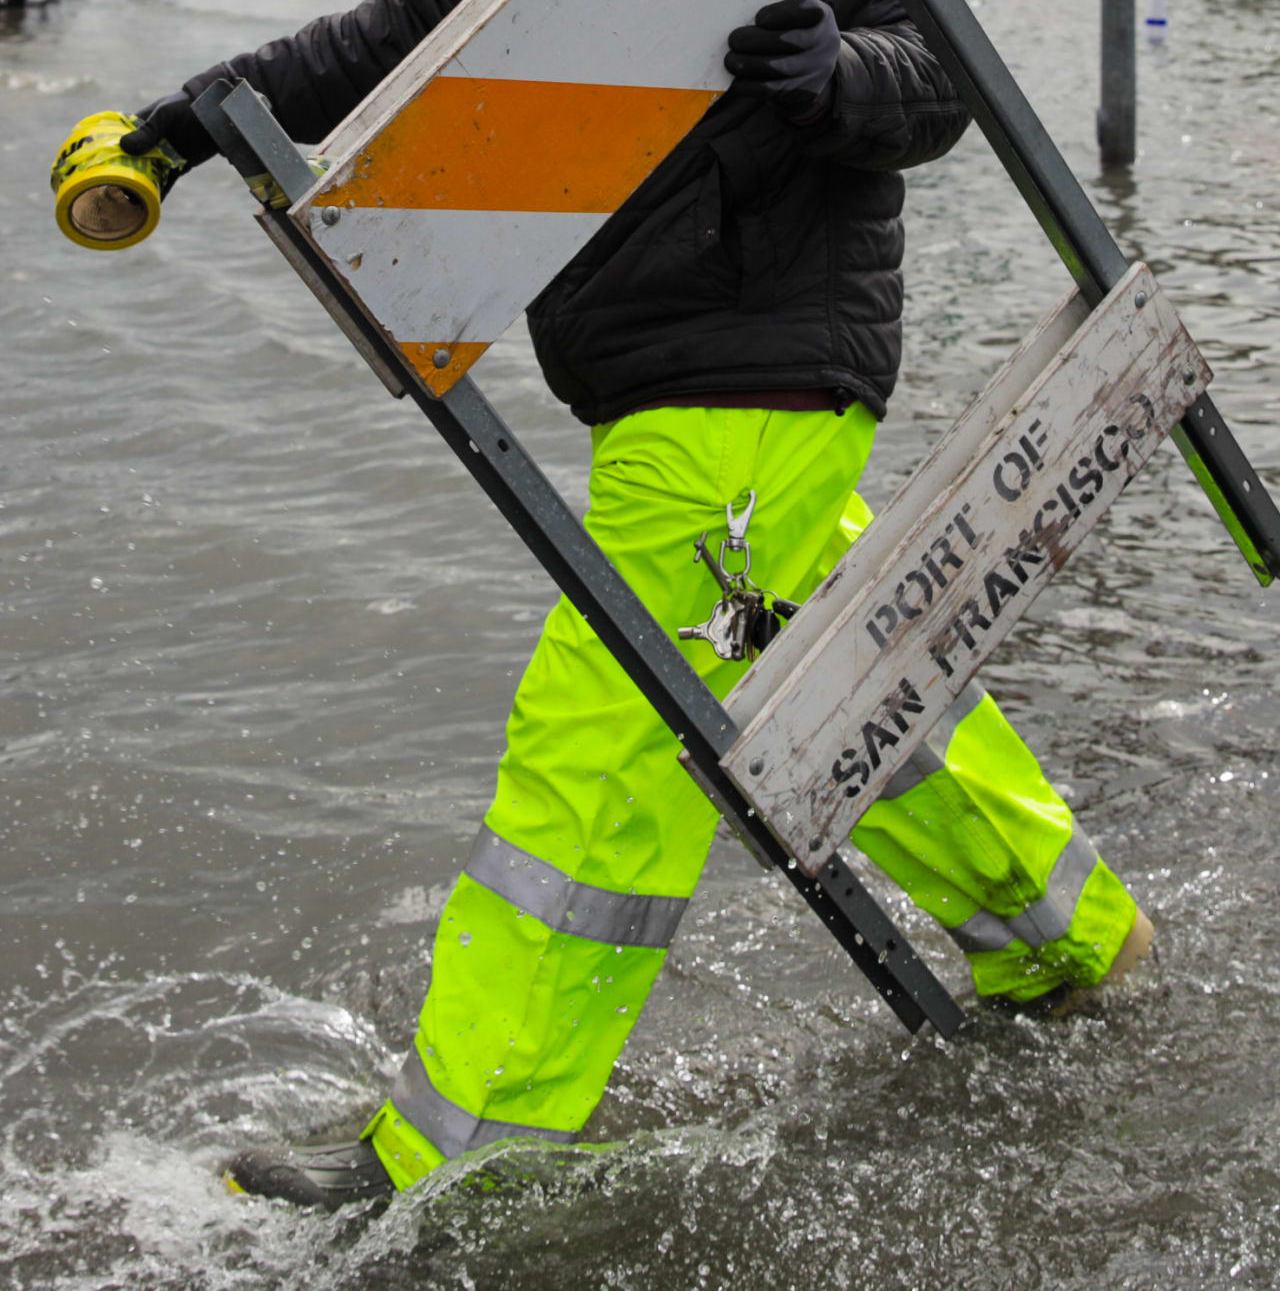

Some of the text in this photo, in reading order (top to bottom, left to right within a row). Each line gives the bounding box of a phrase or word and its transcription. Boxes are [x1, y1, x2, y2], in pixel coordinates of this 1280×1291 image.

[832, 393, 1156, 798] SAN FRANCISCO
[865, 419, 1049, 651] PORT OF
